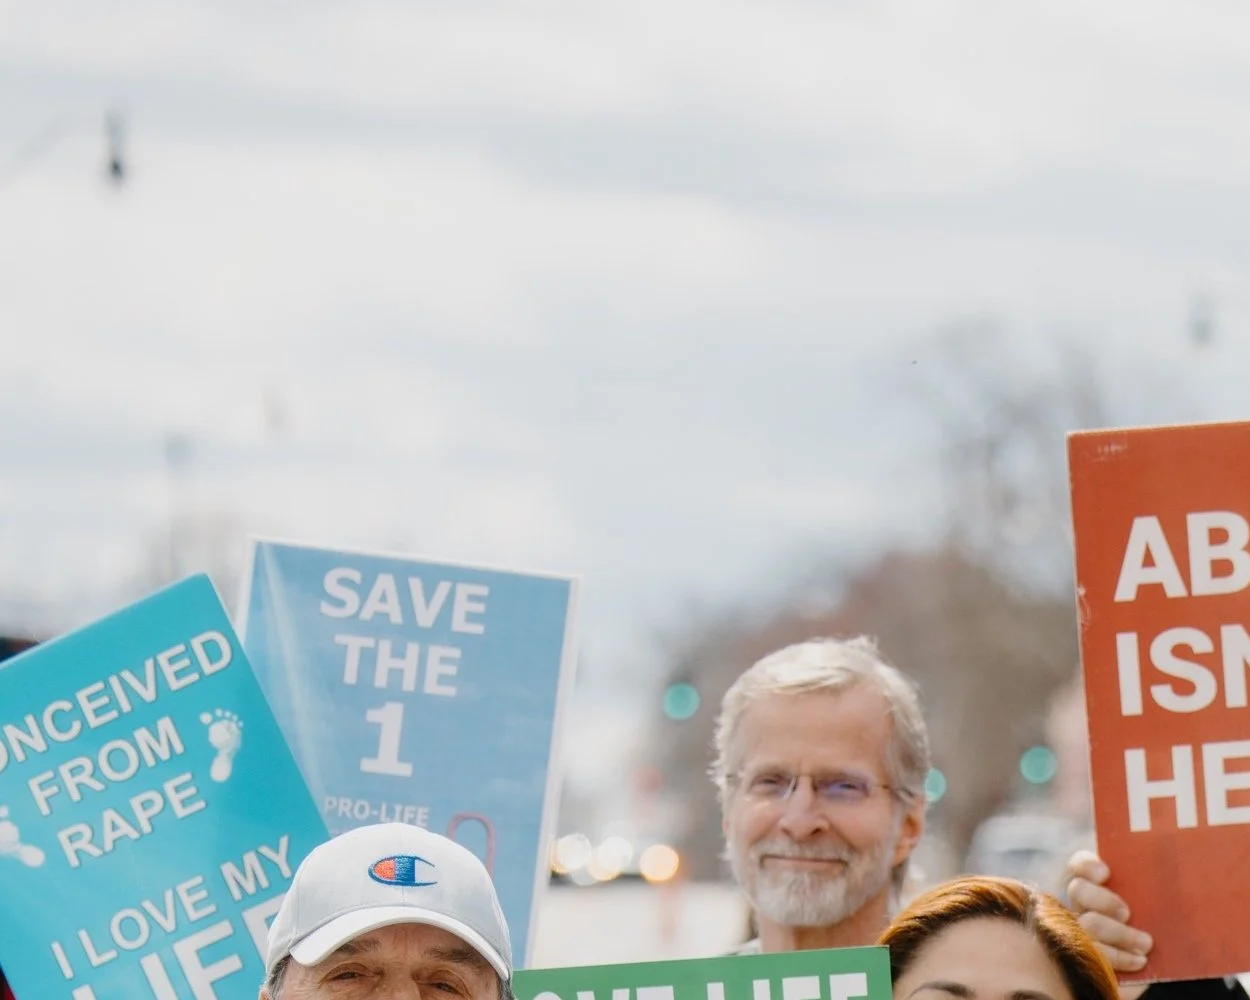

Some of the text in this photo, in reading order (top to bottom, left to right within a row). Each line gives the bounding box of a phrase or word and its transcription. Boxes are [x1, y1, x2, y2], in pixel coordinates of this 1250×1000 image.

[320, 567, 490, 636] SAVE
[0, 629, 234, 773] NCEIVED
[333, 633, 463, 698] THE
[27, 713, 186, 817] FROM
[358, 700, 414, 779] 1
[57, 771, 207, 869] RAPE
[323, 796, 430, 827] PRO-LIFE
[50, 834, 293, 981] I LOVE MY
